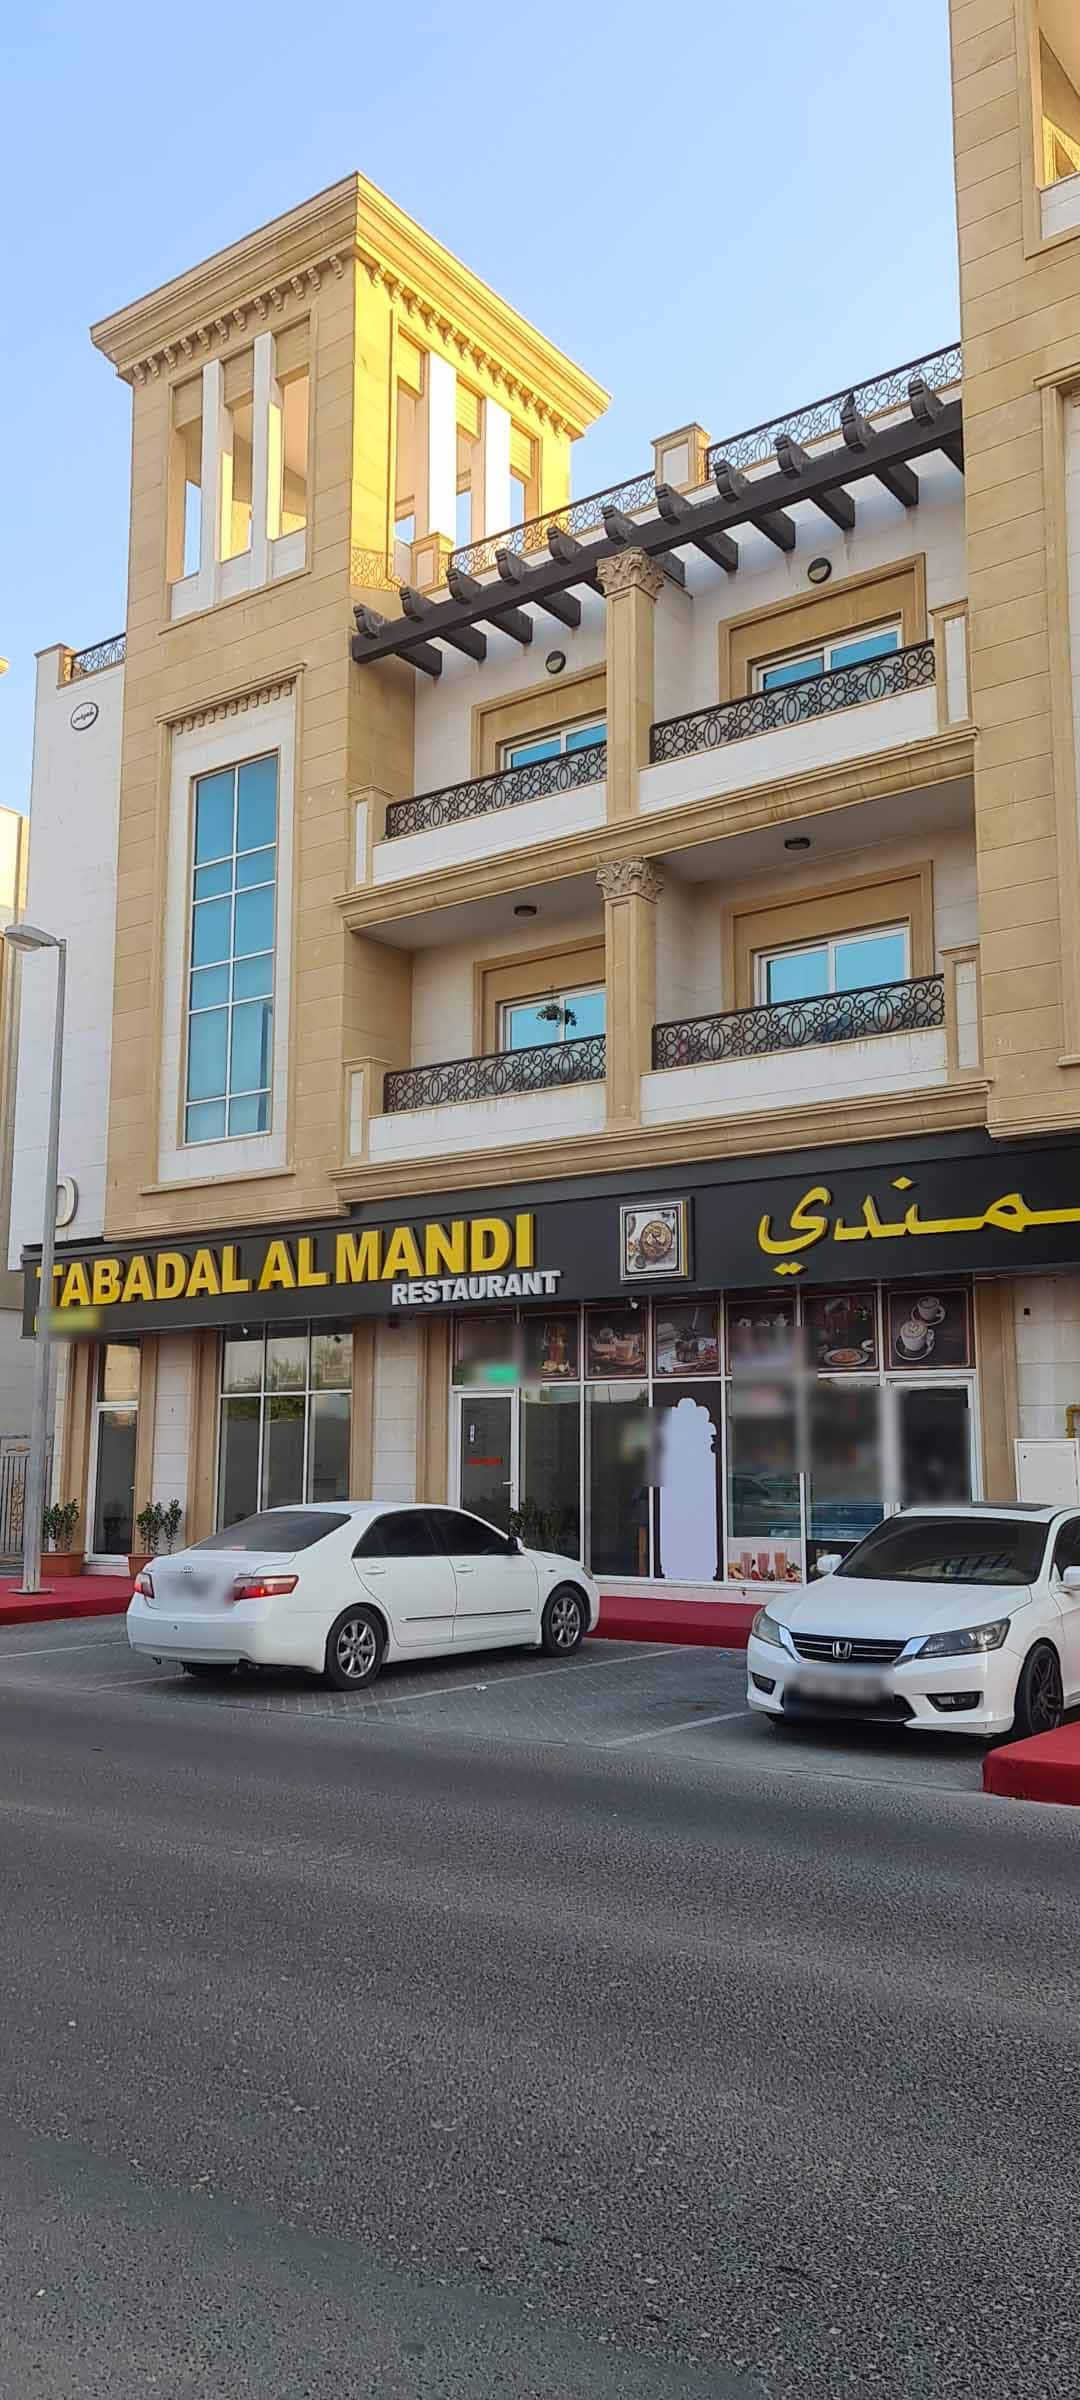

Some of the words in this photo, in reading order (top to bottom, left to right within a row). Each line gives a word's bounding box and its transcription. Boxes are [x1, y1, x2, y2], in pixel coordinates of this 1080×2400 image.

[35, 1243, 252, 1309] TABADAL
[257, 1237, 331, 1291] AL
[335, 1213, 535, 1283] MANDI
[756, 1176, 1080, 1276] مندي
[391, 1270, 562, 1305] RESTAURANT
